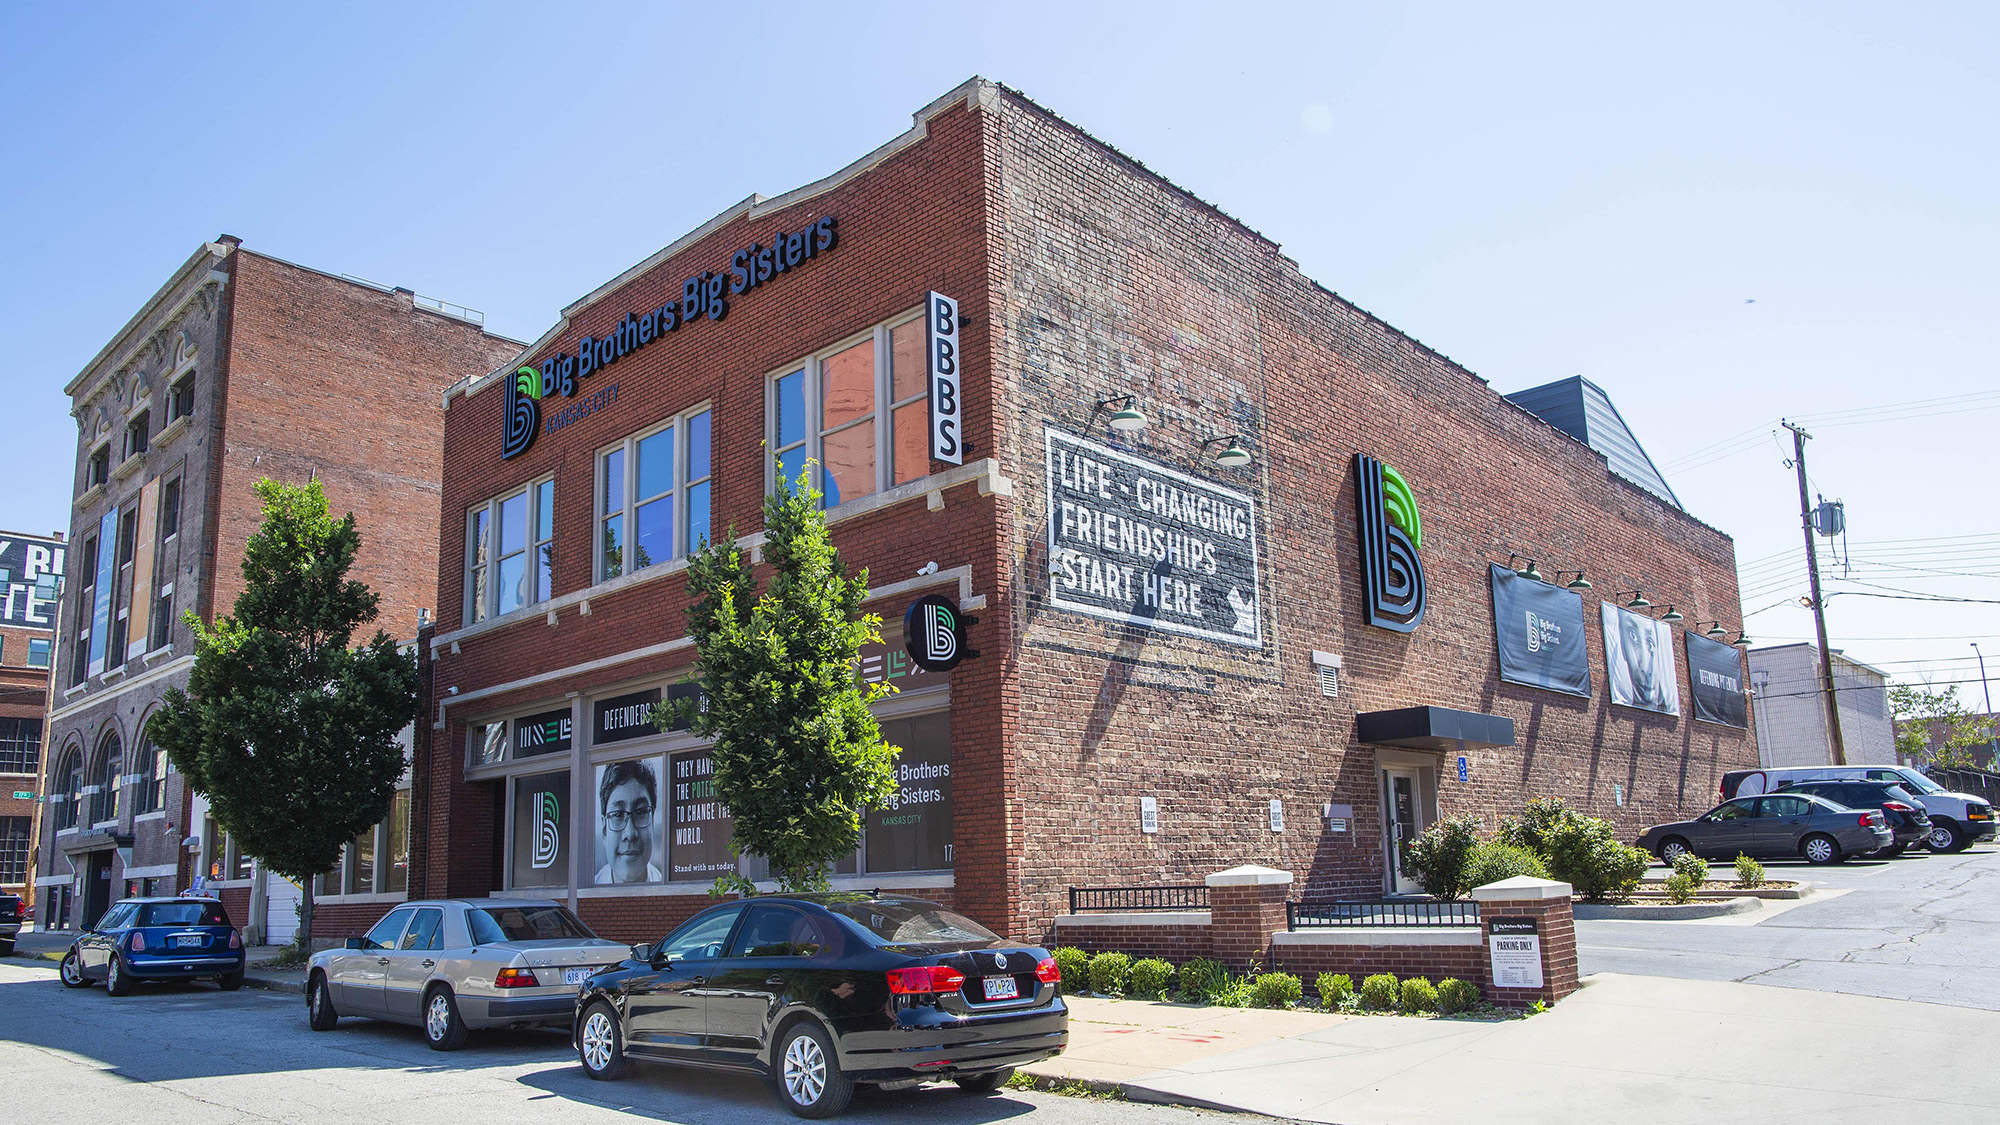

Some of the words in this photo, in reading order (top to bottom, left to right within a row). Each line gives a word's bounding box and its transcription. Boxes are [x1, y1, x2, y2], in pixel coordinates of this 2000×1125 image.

[541, 352, 577, 398] Big
[578, 300, 679, 378] Brothers
[683, 270, 728, 321] Big
[731, 215, 838, 296] Sisters
[935, 296, 958, 458] BBBS
[546, 397, 591, 436] KANSAS
[592, 382, 620, 412] CITY
[1060, 448, 1112, 500] LIFE
[1136, 476, 1248, 540] CHANGING
[1061, 500, 1217, 576] FRIENDSHIPS
[1062, 550, 1135, 601] START
[1143, 571, 1202, 617] HERE
[1699, 669, 1720, 689] DEFENDING
[604, 702, 651, 731] DEFENDERS
[676, 760, 694, 779] THEY
[900, 761, 950, 781] Brothers
[676, 783, 689, 800] THE
[676, 806, 685, 823] TO
[687, 802, 715, 822] CHANGE
[881, 815, 906, 826] KANSAS
[906, 814, 922, 825] CITY
[675, 827, 703, 845] WORLD.
[674, 863, 692, 873] Stand
[692, 862, 707, 872] with
[708, 863, 716, 871] us
[716, 861, 736, 873] today.
[1496, 940, 1519, 951] PARKING
[1519, 940, 1533, 951] ONLY
